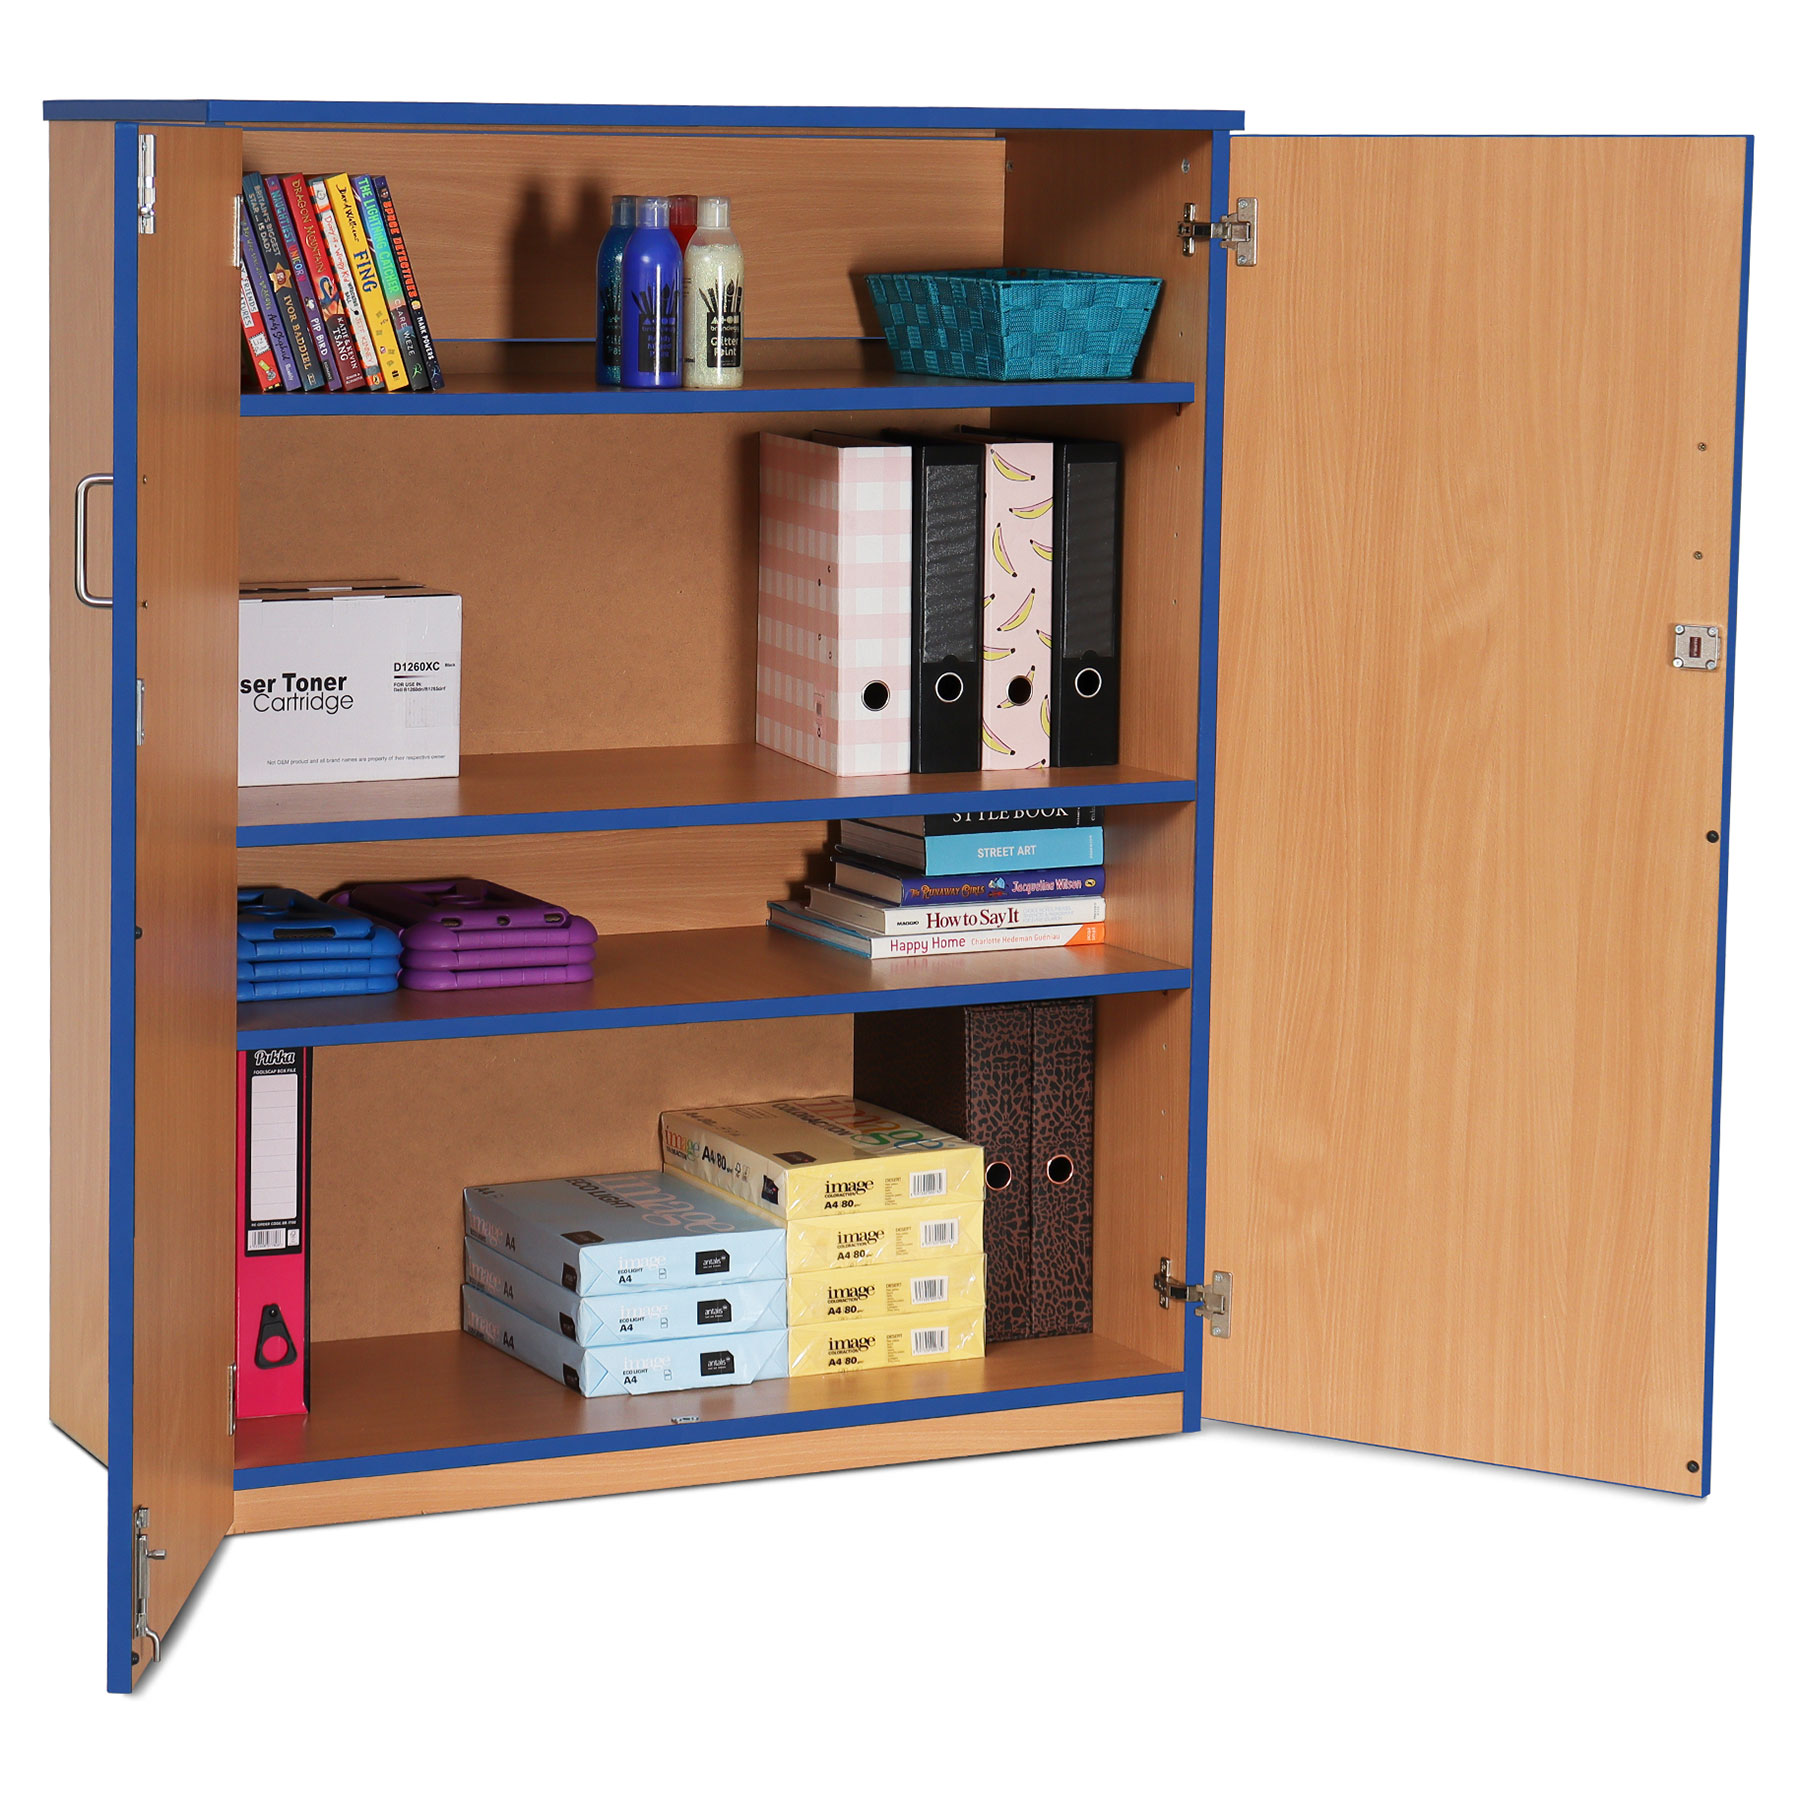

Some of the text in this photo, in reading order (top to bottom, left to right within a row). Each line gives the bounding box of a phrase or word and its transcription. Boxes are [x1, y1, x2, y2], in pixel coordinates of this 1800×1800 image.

[249, 193, 260, 214] STAR
[292, 179, 326, 273] DRAGON MOUNTAIN
[358, 177, 400, 293] THE LIGHTNING CATCHER
[266, 223, 281, 256] BIGGEST
[271, 190, 295, 243] NAUGHTIEST
[288, 244, 307, 282] UNICORN
[354, 249, 378, 292] FING
[284, 295, 298, 322] IVOR
[292, 324, 312, 370] BADDIEL
[394, 299, 416, 356] CLARE WEZE
[417, 316, 427, 335] MARK
[310, 317, 328, 356] PIP BIRD
[332, 328, 349, 361] TSANG
[337, 317, 350, 339] KATIE
[348, 344, 358, 369] KEVIN
[394, 662, 440, 672] D1260XC
[282, 673, 347, 692] Toner
[253, 692, 353, 714] Cartridge
[1014, 807, 1068, 819] BOOK
[978, 845, 1036, 858] STREET ART
[1011, 878, 1082, 894] Jacqueline Wilson
[926, 912, 963, 929] How
[964, 913, 977, 926] to
[980, 909, 1006, 928] Say
[1008, 908, 1019, 922] It
[891, 937, 966, 954] Happy Home
[971, 937, 1000, 946] Charlotte
[1002, 935, 1033, 943] Hedeman
[254, 1050, 295, 1066] Pukka
[794, 1100, 943, 1150] image
[702, 1146, 726, 1171] A4 80
[824, 1180, 874, 1195] image
[841, 1200, 854, 1208] 80
[505, 1233, 515, 1252] A4
[837, 1230, 884, 1245] image
[837, 1250, 865, 1260] A4 80
[619, 1275, 632, 1284] A4
[504, 1281, 514, 1299] A4
[827, 1285, 875, 1300] image
[827, 1305, 857, 1315] A4 80
[620, 1324, 633, 1332] A4
[503, 1331, 514, 1349] A4
[829, 1336, 876, 1352] image
[828, 1357, 857, 1366] A4 80
[624, 1376, 637, 1384] A4
